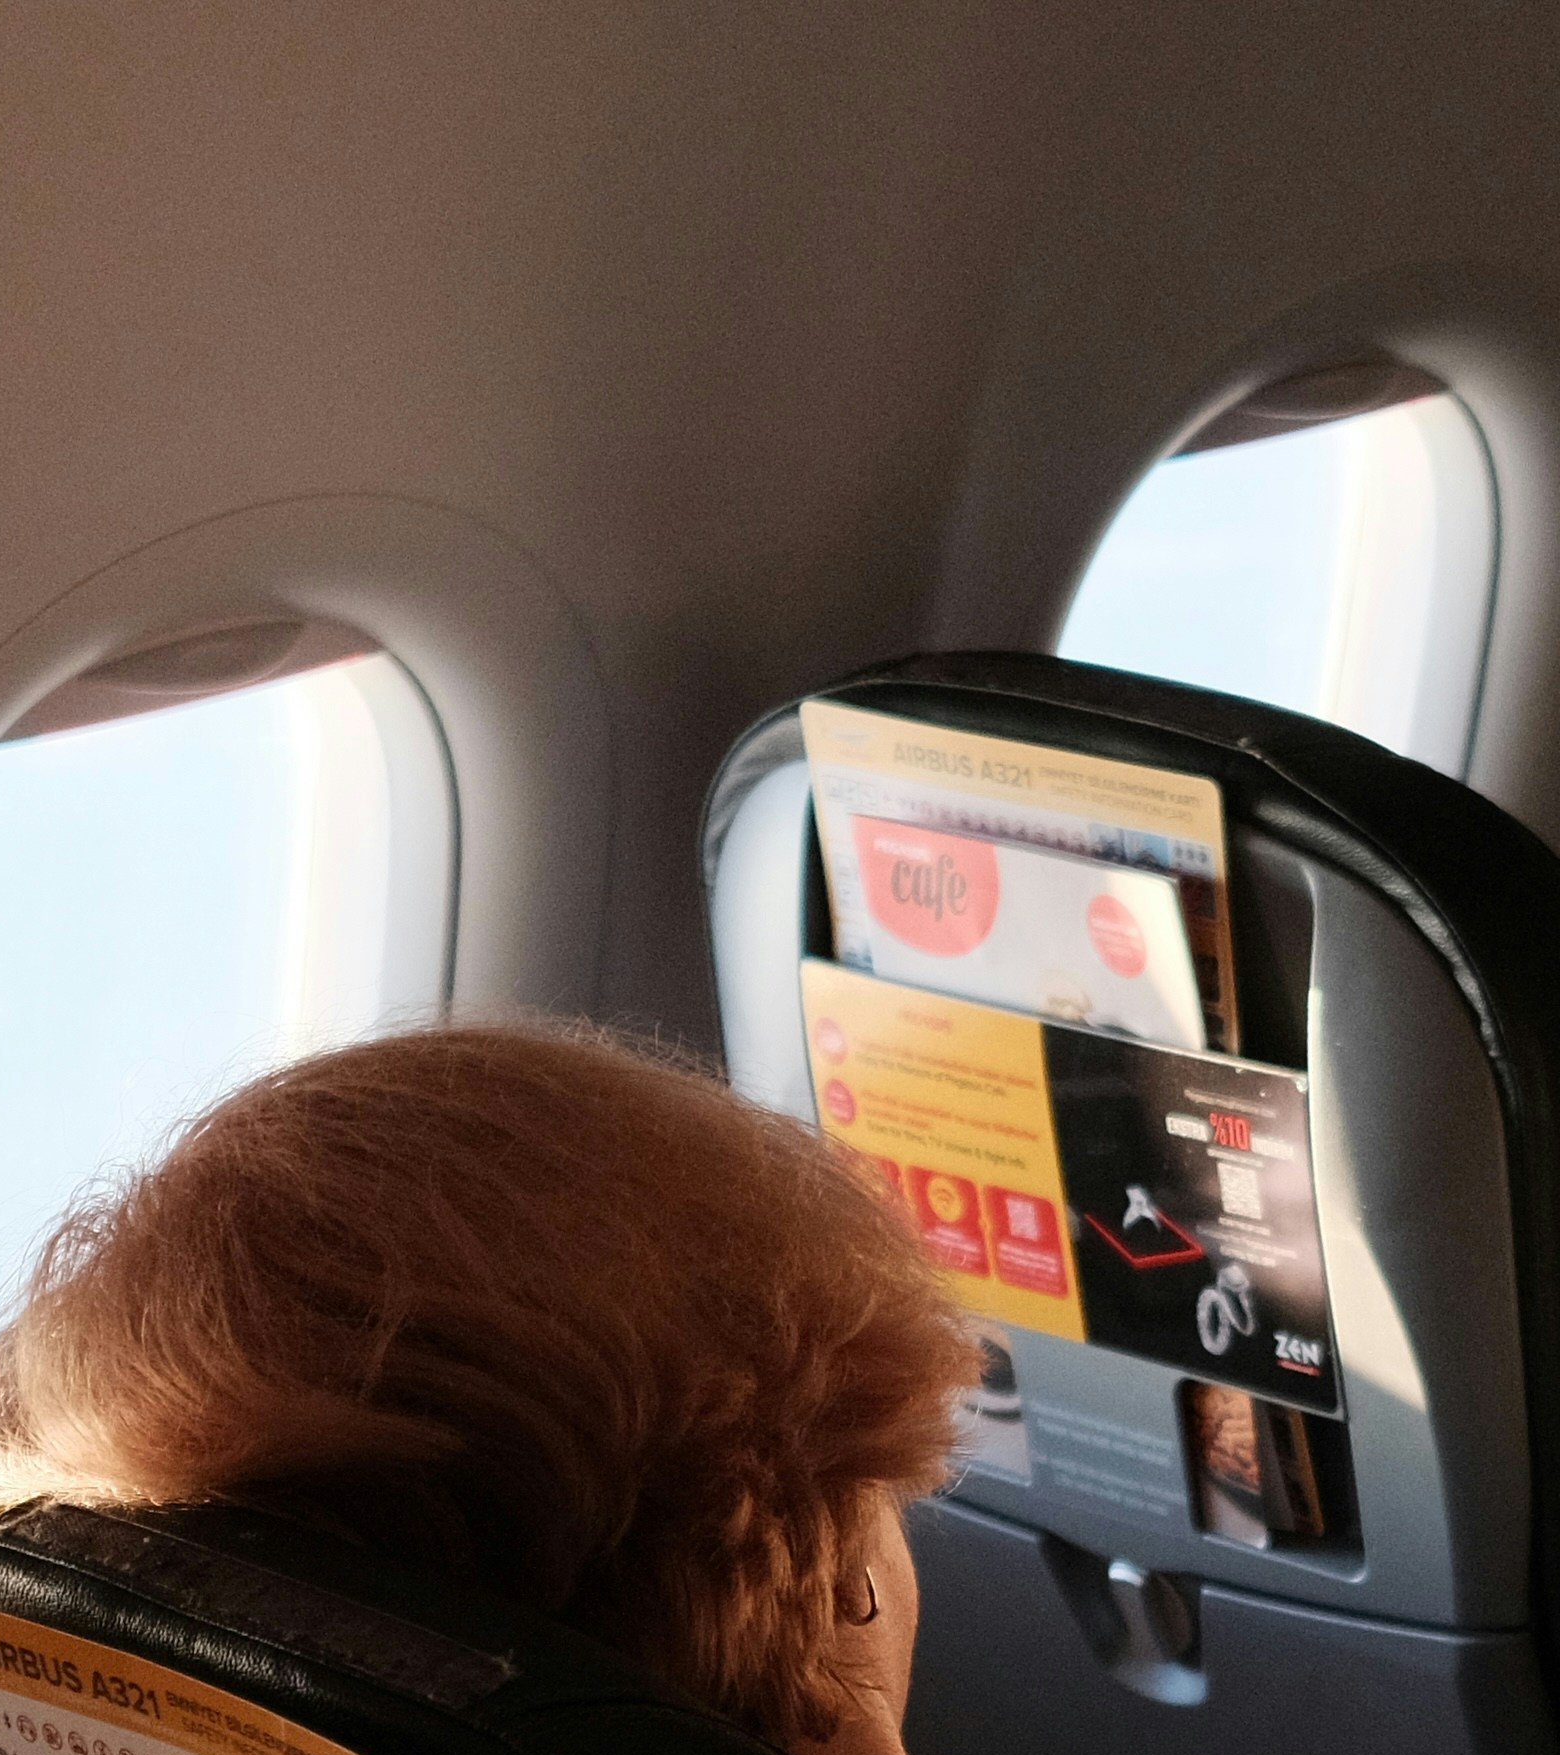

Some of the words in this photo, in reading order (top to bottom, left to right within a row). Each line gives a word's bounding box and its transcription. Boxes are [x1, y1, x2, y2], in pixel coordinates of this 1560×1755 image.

[893, 741, 974, 780] AIRBUS
[979, 757, 1032, 790] A321
[890, 853, 967, 922] cafe
[1209, 1111, 1250, 1152] %10
[90, 1668, 161, 1721] A321
